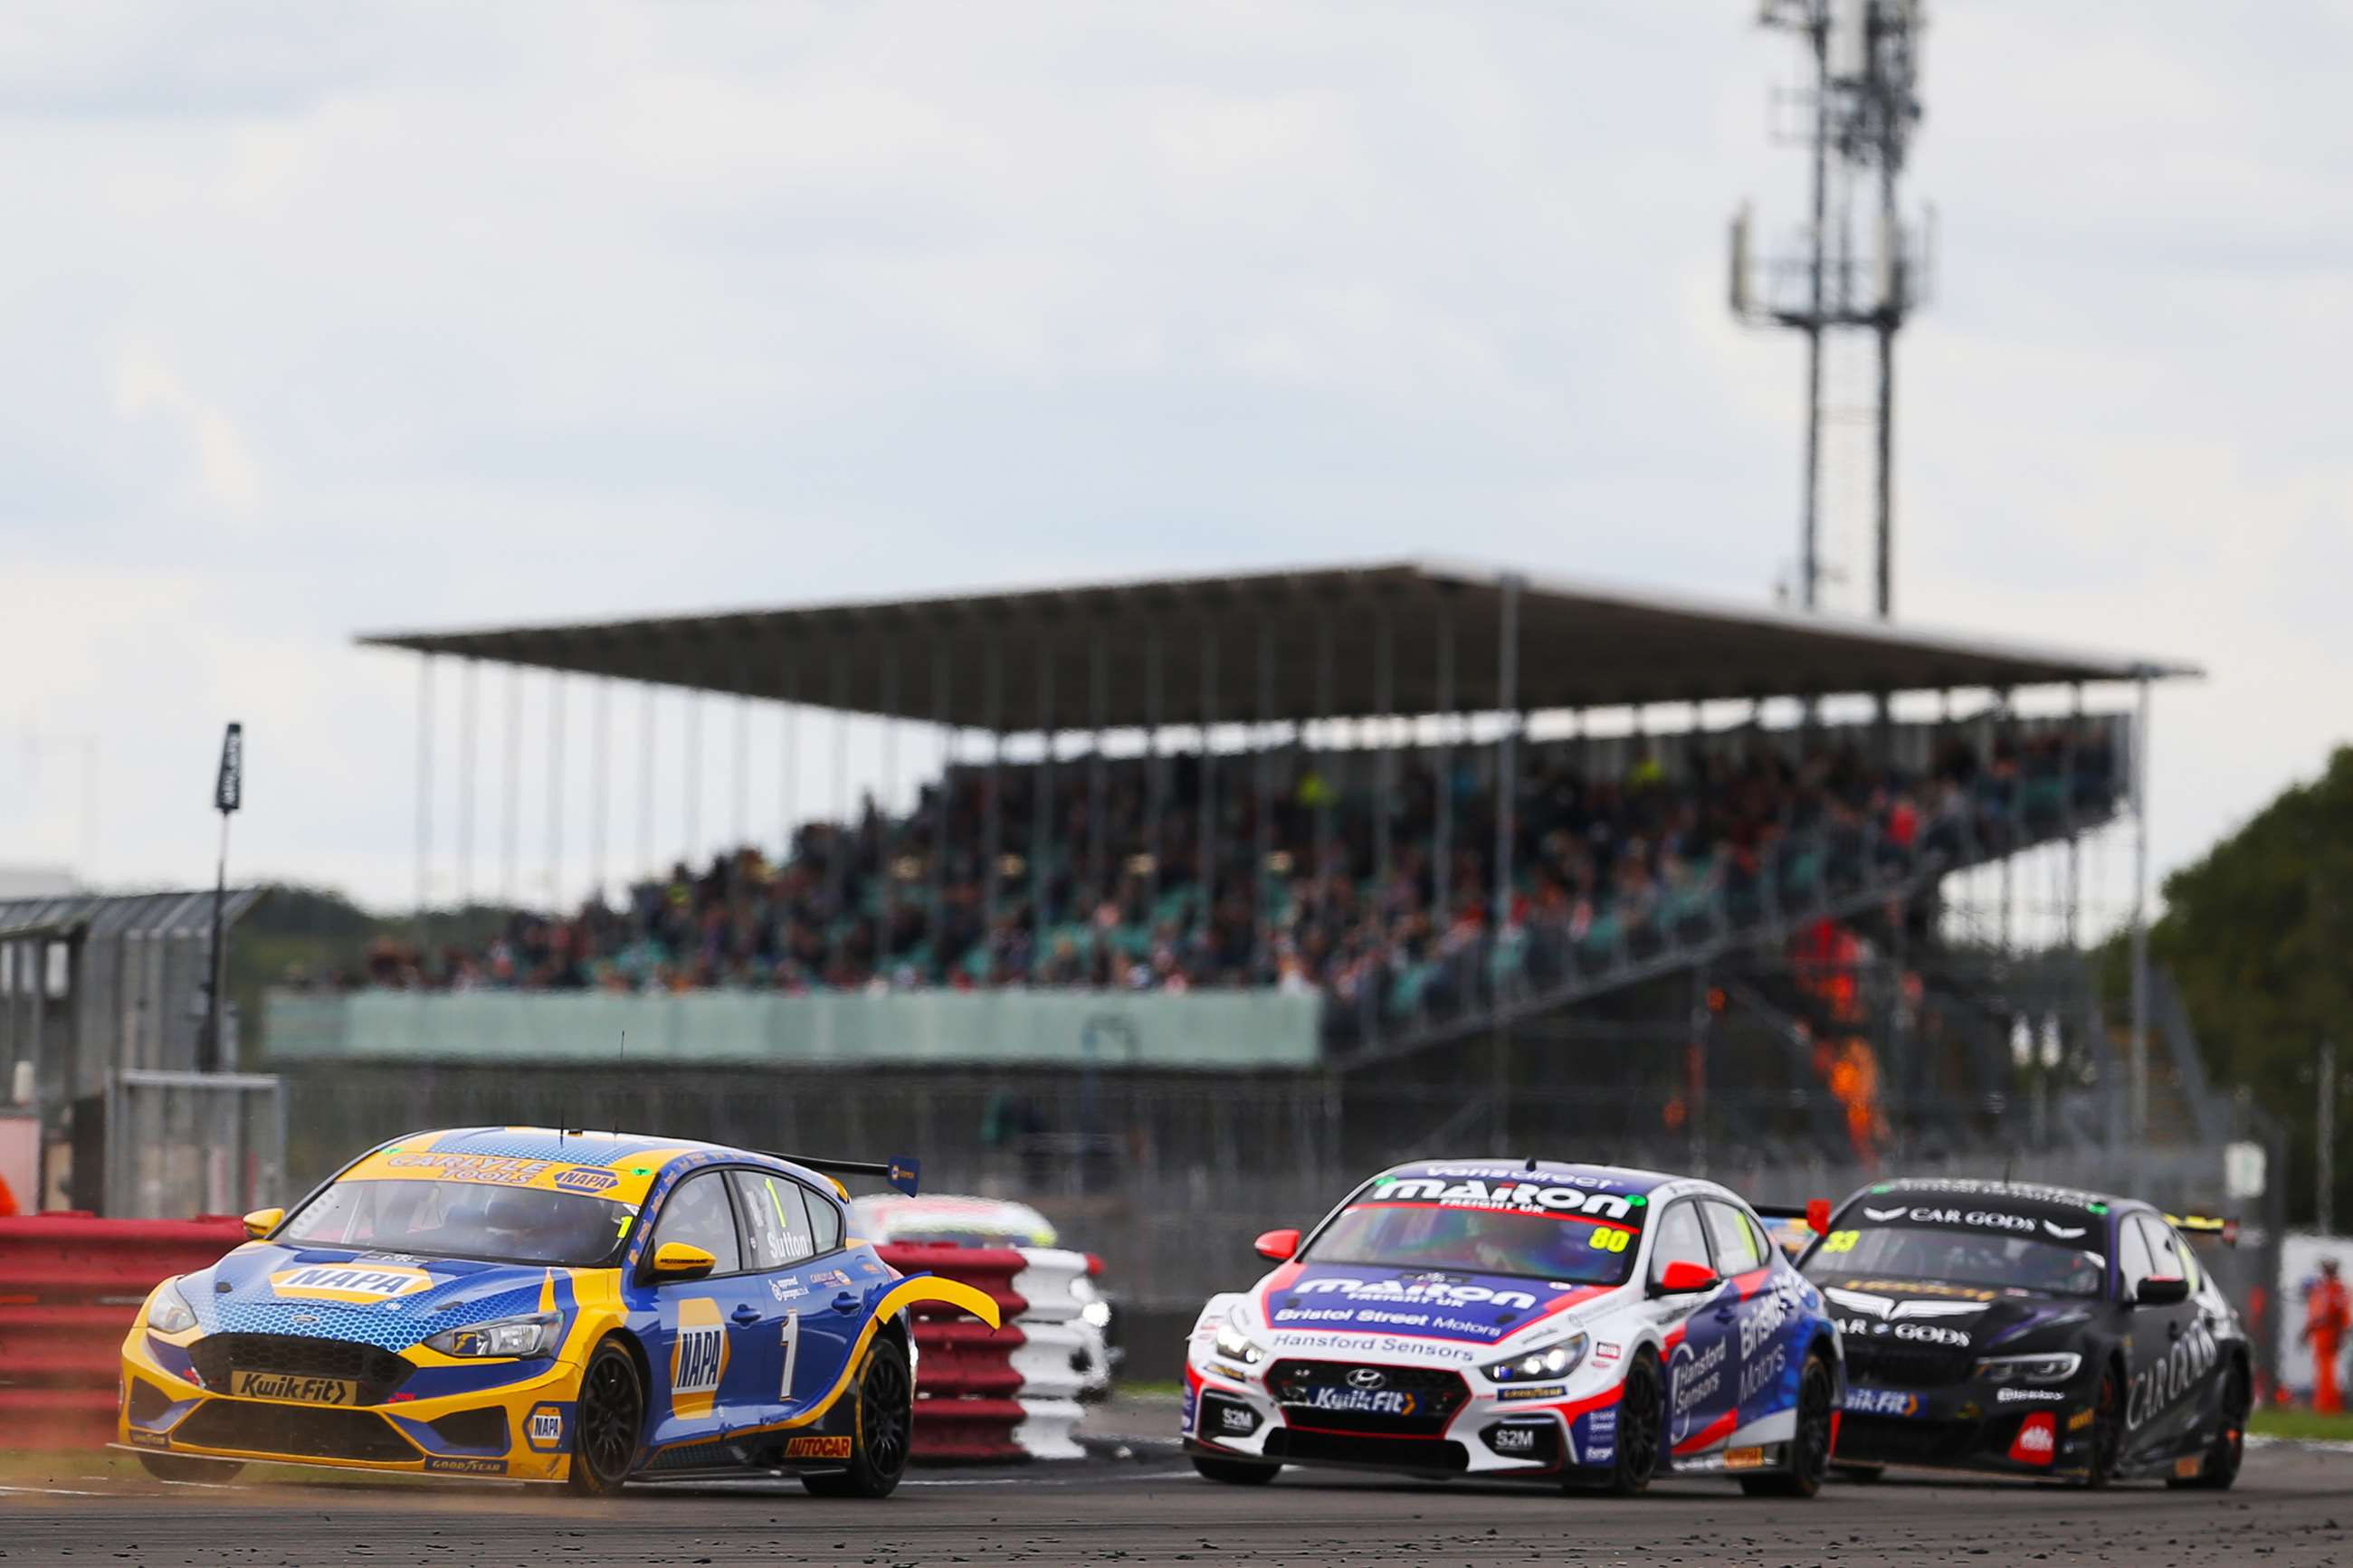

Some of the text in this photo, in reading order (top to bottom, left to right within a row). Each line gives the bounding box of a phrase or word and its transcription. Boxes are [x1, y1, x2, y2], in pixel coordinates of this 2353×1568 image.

[388, 1154, 551, 1174] CARLYLE
[440, 1167, 536, 1183] TOOLS
[561, 1172, 609, 1189] NAPA
[765, 1178, 786, 1228] 1
[617, 1216, 634, 1239] 1
[1909, 1208, 2036, 1232] CAR GODS
[767, 1231, 809, 1259] Sutton
[1588, 1227, 1630, 1253] 80
[288, 1269, 412, 1293] NAPA
[1274, 1307, 1502, 1337] Bristol Street Motors
[1895, 1323, 1971, 1347] GODS
[677, 1330, 721, 1388] NAPA
[779, 1308, 798, 1402] 1
[1273, 1334, 1474, 1362] Hansford Sensors
[1679, 1335, 1726, 1383] Hansford
[1676, 1373, 1720, 1415] Sensors
[534, 1417, 558, 1437] NAPA
[1223, 1407, 1253, 1427] S2M
[787, 1438, 850, 1457] AUTOCAR
[1496, 1430, 1534, 1448] S2M
[433, 1459, 500, 1471] GOODYEAR
